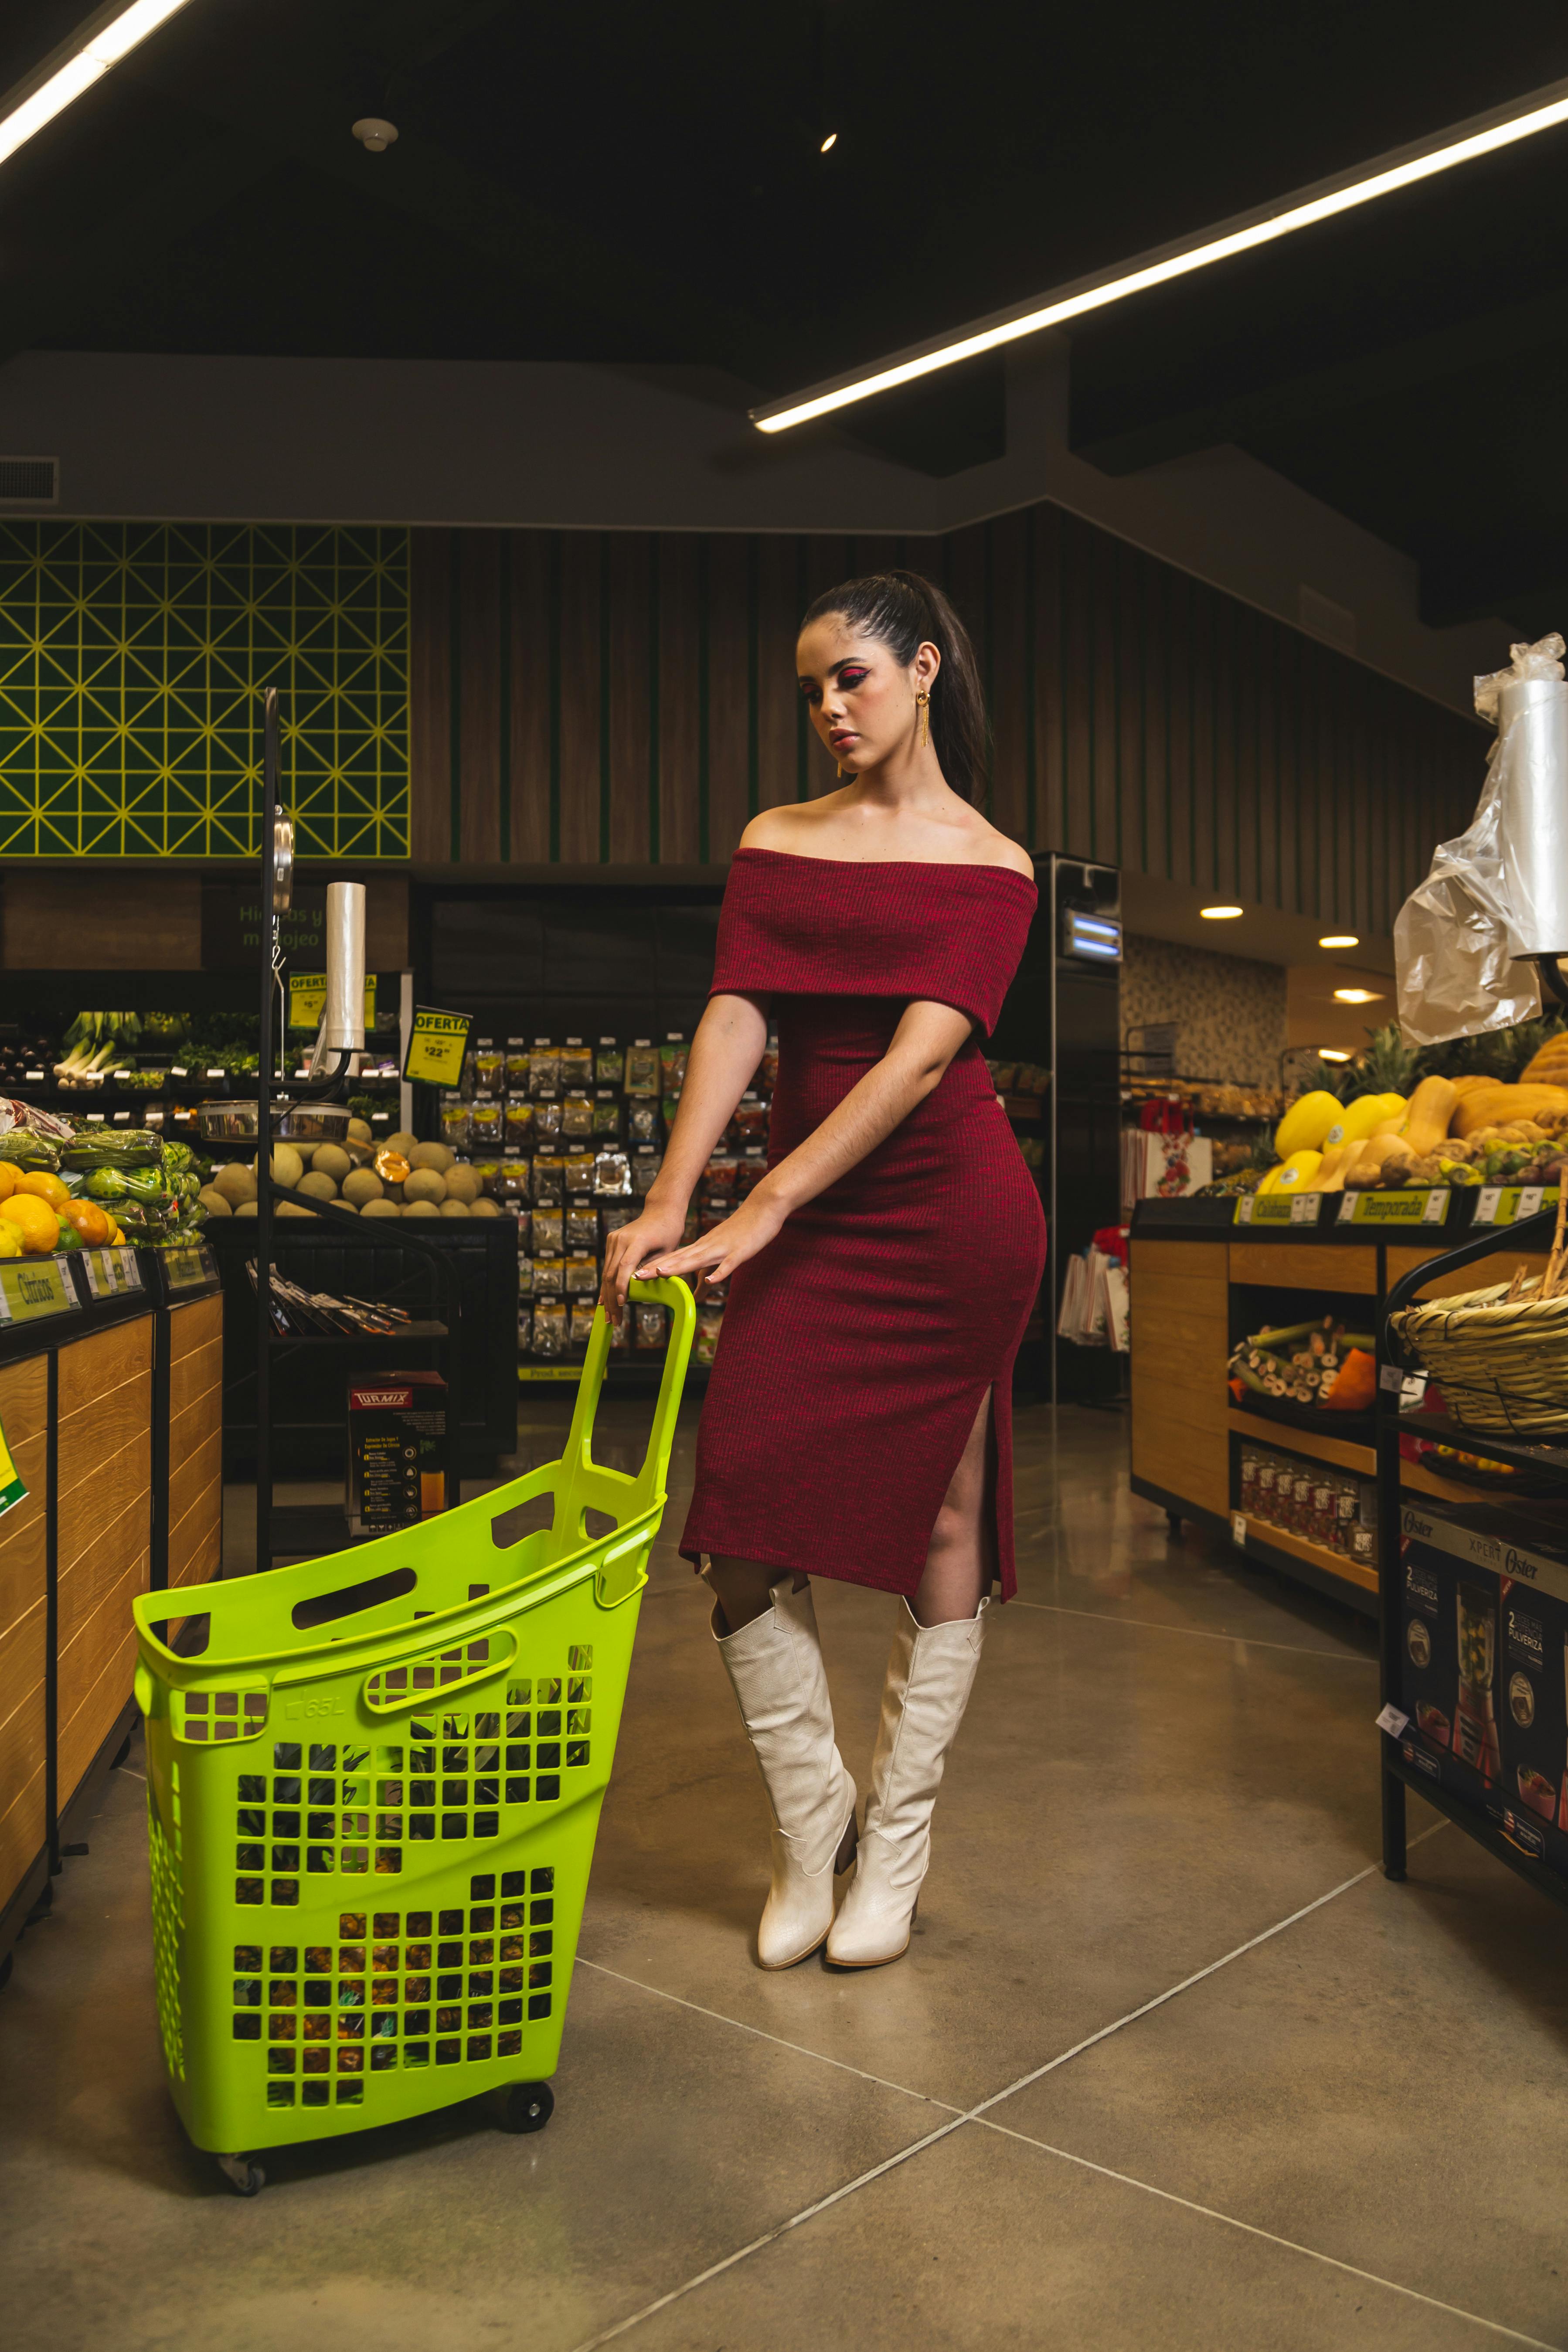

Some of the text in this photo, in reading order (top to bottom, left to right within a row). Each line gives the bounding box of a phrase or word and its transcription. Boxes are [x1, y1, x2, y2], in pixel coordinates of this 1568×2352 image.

[312, 910, 323, 927] y
[244, 933, 319, 950] mnojeo
[292, 977, 327, 988] OFERT
[416, 1016, 468, 1030] OFERTA
[1364, 1196, 1422, 1219] Temporada
[354, 1392, 409, 1405] TURMIX
[1404, 1511, 1433, 1538] Oster
[1356, 1533, 1373, 1542] BERRY
[1469, 1538, 1501, 1562] XPERT
[1506, 1548, 1538, 1579] Oster
[1407, 1566, 1412, 1581] 2
[1407, 1580, 1438, 1602] PULVERIZA
[1509, 1611, 1514, 1628] 2
[1509, 1627, 1543, 1653] PULVERIZA
[305, 1697, 345, 1718] 65L
